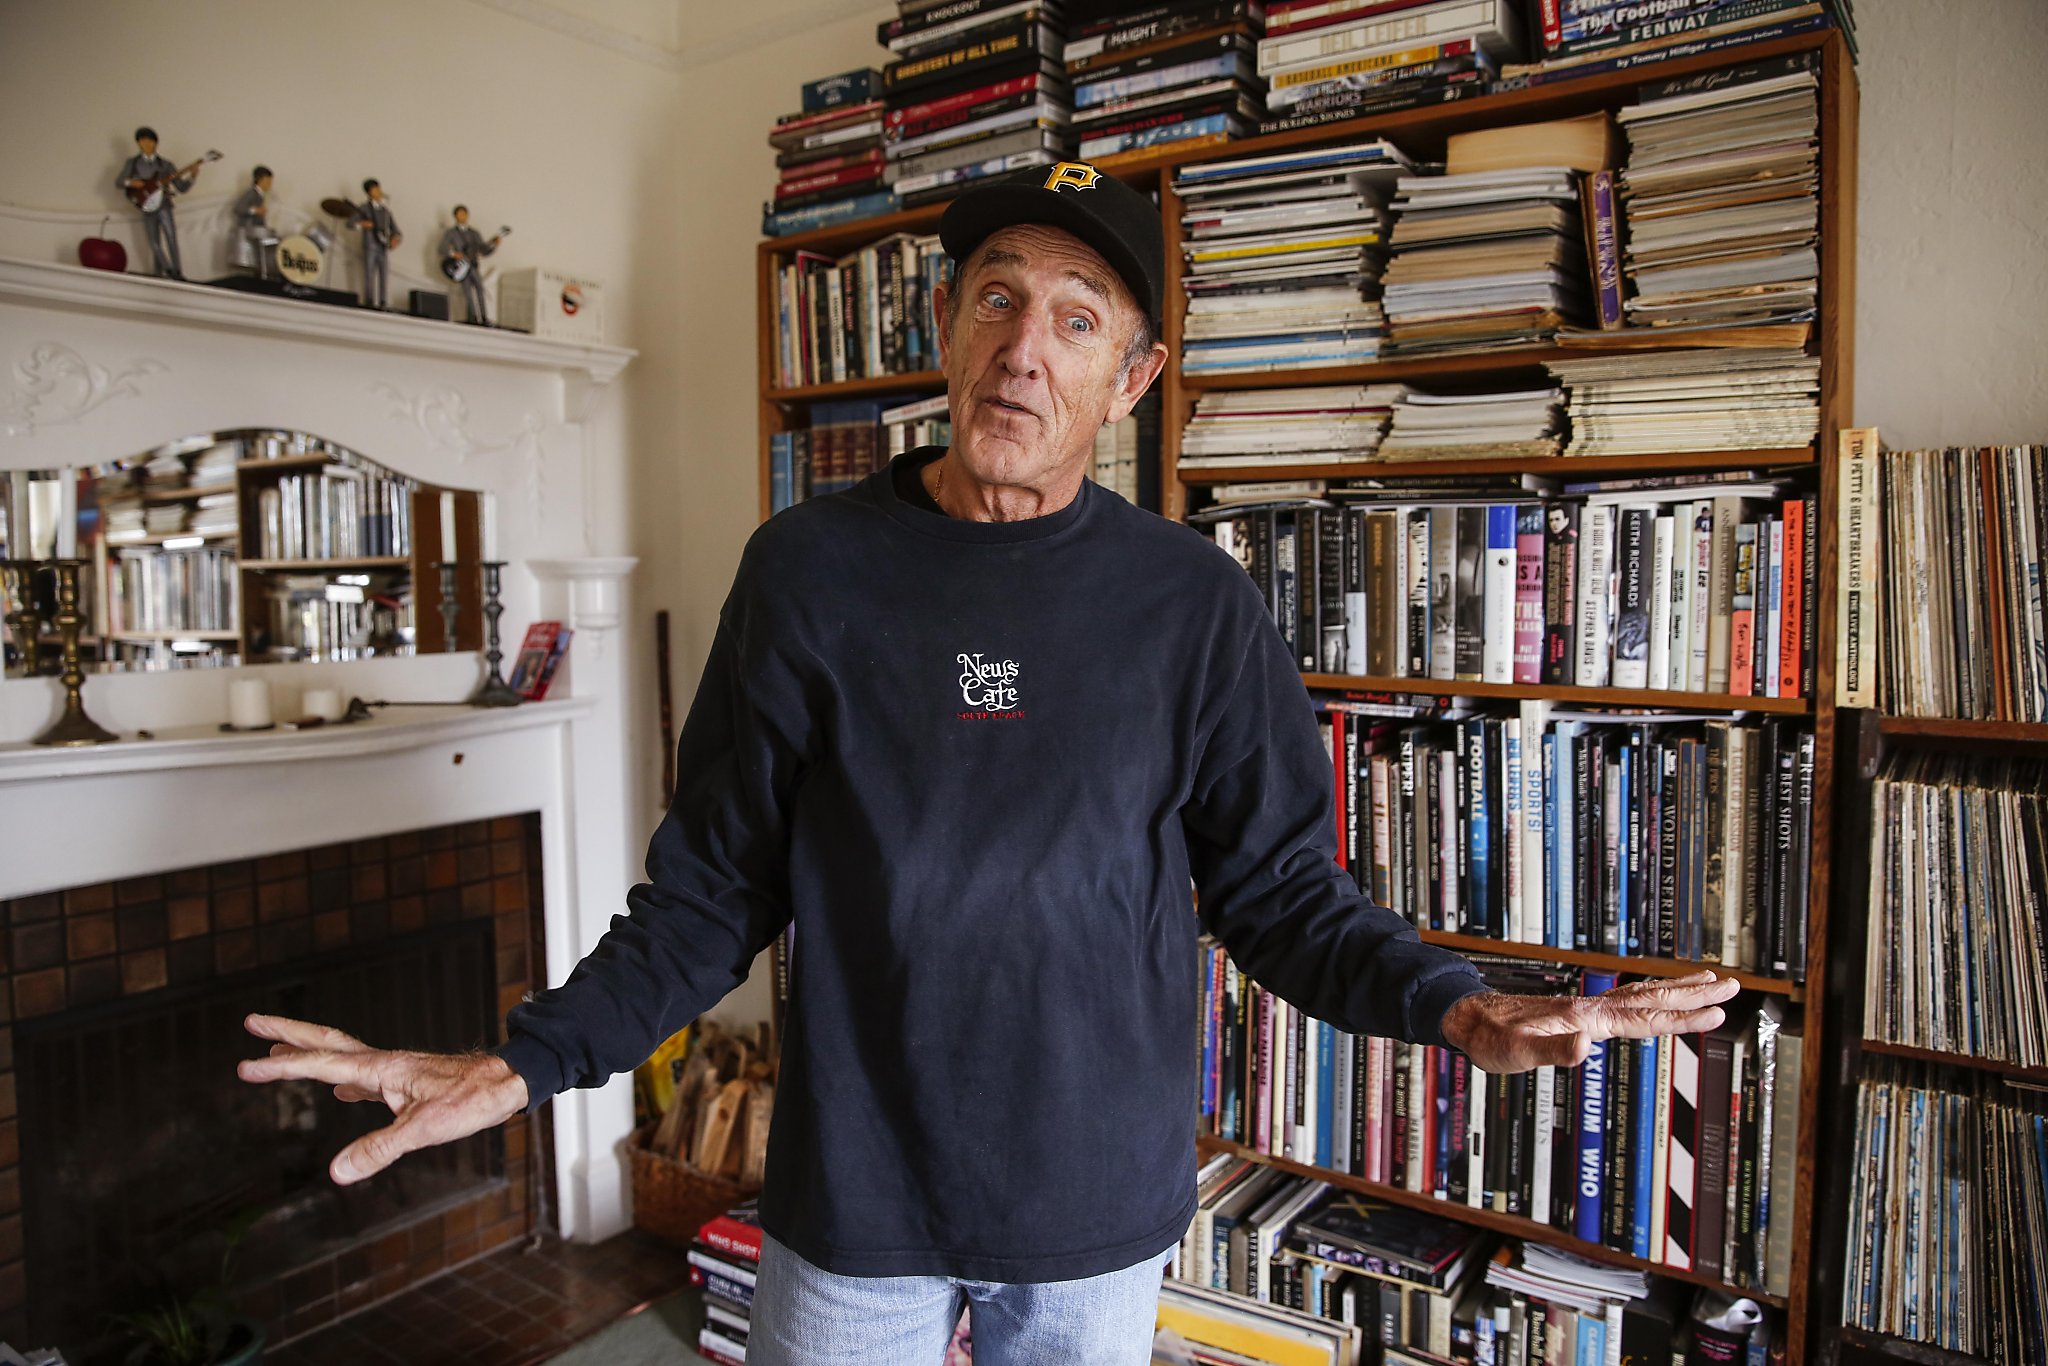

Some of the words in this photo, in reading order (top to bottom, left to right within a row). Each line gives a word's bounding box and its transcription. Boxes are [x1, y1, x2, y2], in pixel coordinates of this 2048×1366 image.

[1630, 12, 1709, 42] FENWAY
[895, 54, 951, 81] GREATEST
[951, 48, 966, 66] OF
[967, 44, 989, 61] ALL
[1286, 66, 1333, 86] BASEBALL
[1336, 54, 1395, 76] AMERICANA
[1616, 57, 1630, 69] by
[1631, 50, 1667, 66] Tommy
[1669, 42, 1708, 58] Hilfiger
[1295, 91, 1362, 115] WARRIORS
[1259, 119, 1279, 134] THE
[1279, 114, 1319, 131] ROLLING
[1319, 108, 1356, 126] STONES
[1850, 439, 1863, 461] TOM
[1850, 462, 1863, 495] PETTY
[1629, 511, 1642, 547] KEITH
[1720, 507, 1730, 534] ANNIE
[1805, 500, 1817, 536] SACRED
[1696, 539, 1709, 568] Spike
[1804, 536, 1816, 581] JOURNEY
[1259, 543, 1269, 600] MORRISO
[1626, 549, 1641, 609] RICHARDS
[1698, 570, 1710, 588] Lee
[1849, 594, 1859, 611] THE
[1585, 601, 1597, 638] STEPHEN
[1848, 613, 1858, 633] LIVE
[957, 653, 1020, 686] News
[1583, 640, 1596, 667] DAVIS
[1847, 636, 1858, 690] ANTHOLOGY
[1346, 744, 1356, 777] Portrait
[1508, 737, 1521, 759] NEIL
[1346, 777, 1356, 785] of
[1400, 740, 1415, 797] SUPER!
[1470, 734, 1484, 822] FOOTBALL
[1508, 764, 1521, 811] LEIFER'S
[1528, 769, 1542, 833] SPORTS!
[1748, 787, 1760, 807] THE
[1780, 772, 1793, 803] BEST
[1347, 814, 1357, 829] The
[1405, 812, 1413, 822] The
[1729, 805, 1743, 853] PASSION
[1777, 806, 1793, 850] SHOTS
[1348, 830, 1358, 861] Season
[1662, 804, 1677, 869] WORLD
[1746, 811, 1759, 869] AMERICAN
[1660, 874, 1675, 941] SERIES
[1259, 1038, 1270, 1087] PARADISE
[1619, 1044, 1631, 1084] GREATEST
[1396, 1072, 1406, 1089] eve
[1582, 1042, 1604, 1134] AXIMUM
[1618, 1085, 1629, 1103] LIVE
[1779, 1046, 1796, 1121] ANNIE
[1395, 1089, 1408, 1117] arnold
[1539, 1089, 1551, 1146] PRINTS
[1409, 1118, 1421, 1162] HARRIS
[1454, 1100, 1466, 1151] CULTURE
[1580, 1147, 1601, 1199] WHO
[1614, 1179, 1626, 1189] IN
[1613, 1190, 1625, 1206] THE
[1773, 1134, 1792, 1261] LEIBOVITZ
[1612, 1206, 1625, 1236] WORLD
